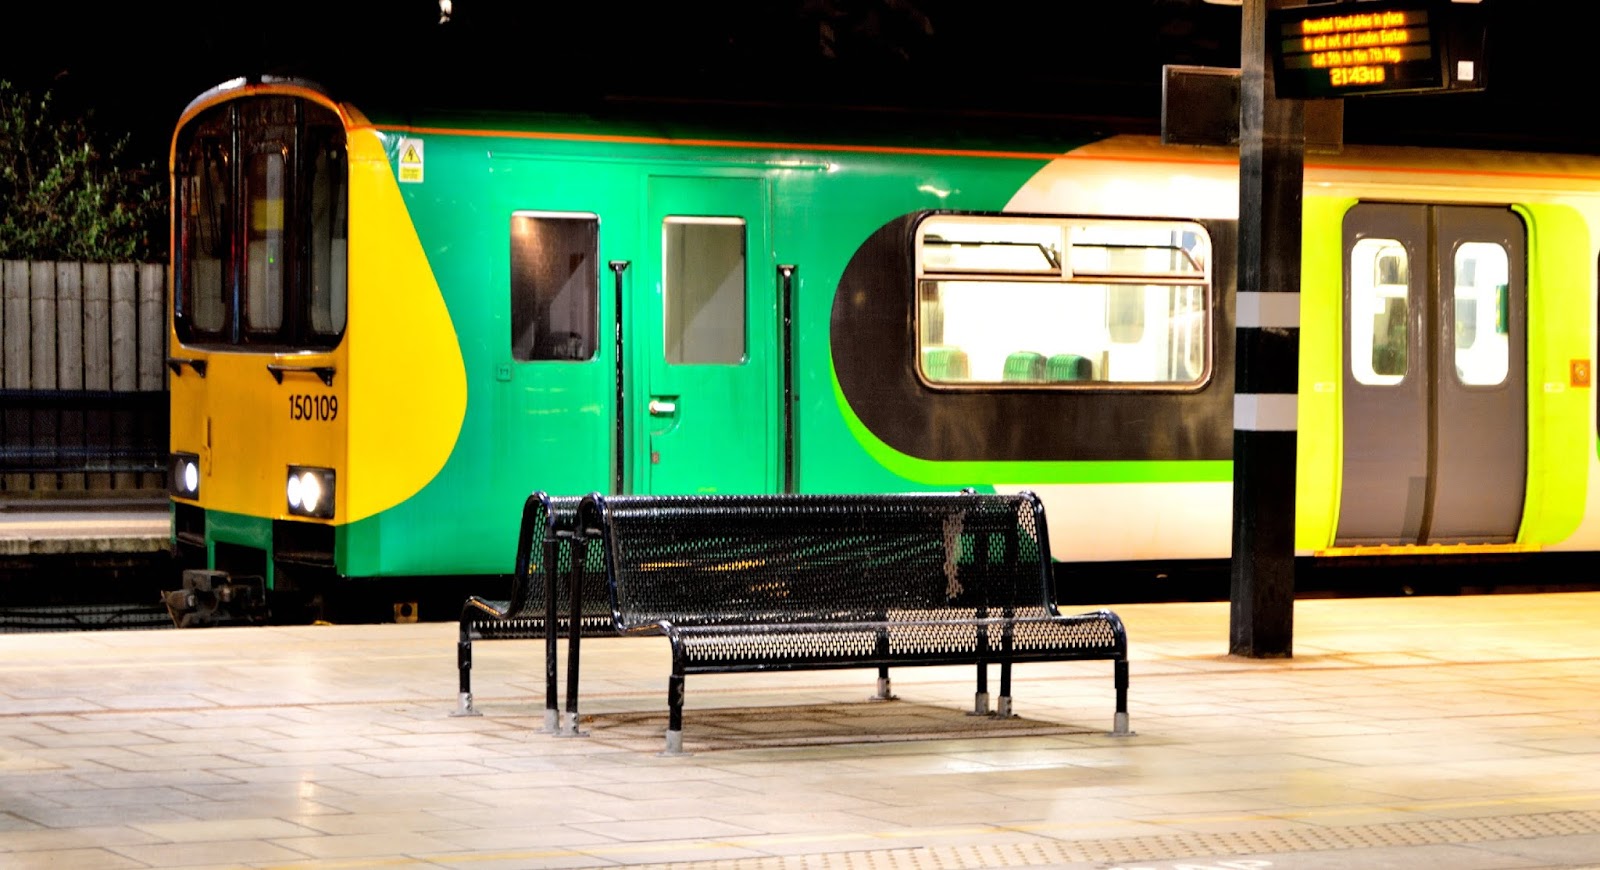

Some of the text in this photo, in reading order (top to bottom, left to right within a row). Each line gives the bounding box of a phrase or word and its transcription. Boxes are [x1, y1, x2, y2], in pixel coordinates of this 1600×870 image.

[1374, 13, 1381, 26] in
[1383, 11, 1404, 28] place
[1353, 31, 1379, 46] London
[289, 394, 338, 421] 150109
